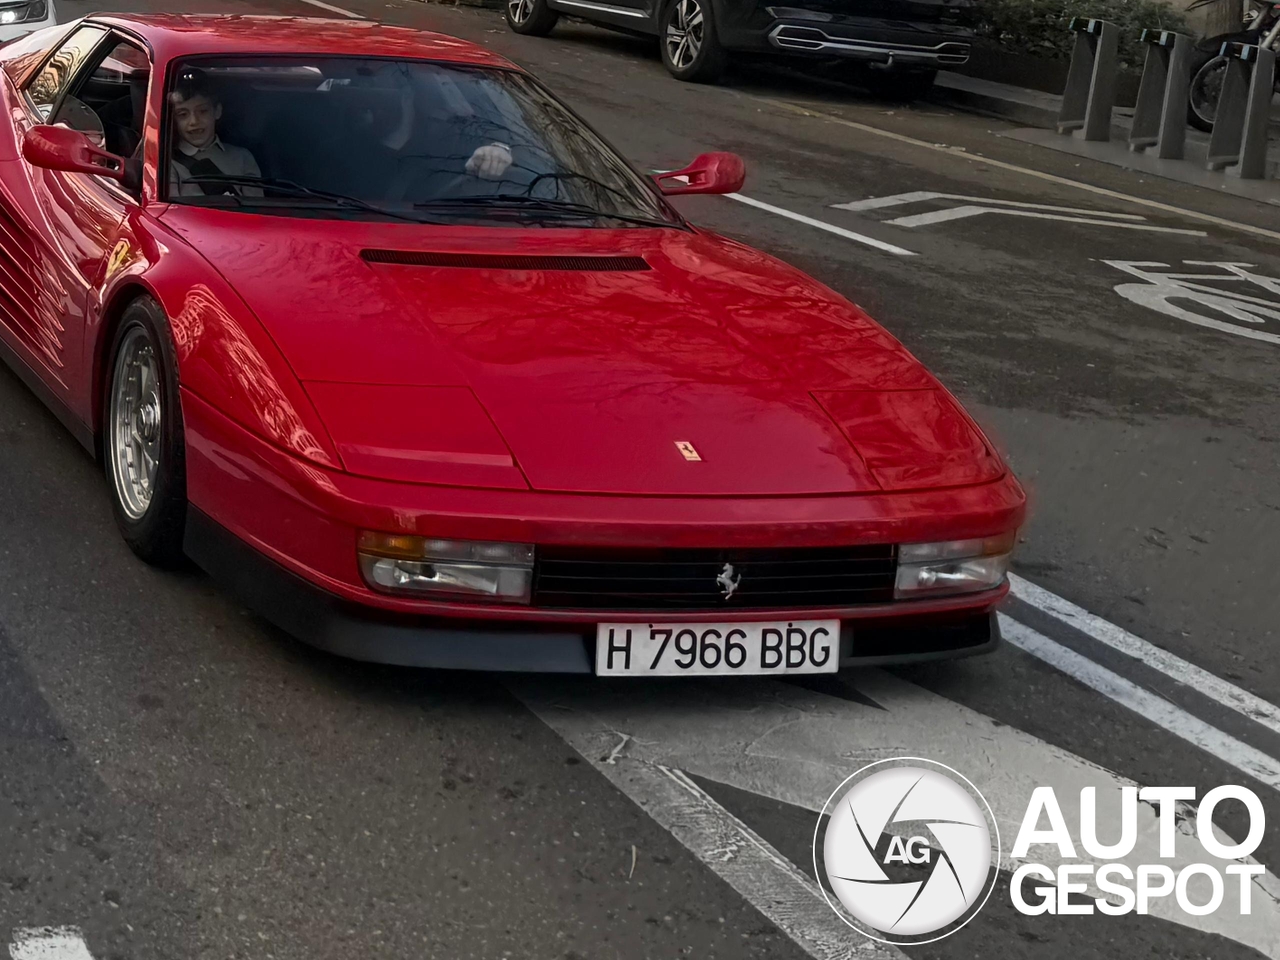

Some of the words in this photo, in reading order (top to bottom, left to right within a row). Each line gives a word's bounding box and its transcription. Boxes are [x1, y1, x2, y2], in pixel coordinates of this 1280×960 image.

[607, 629, 632, 669] H
[649, 628, 747, 669] 7966
[760, 627, 830, 669] BBG
